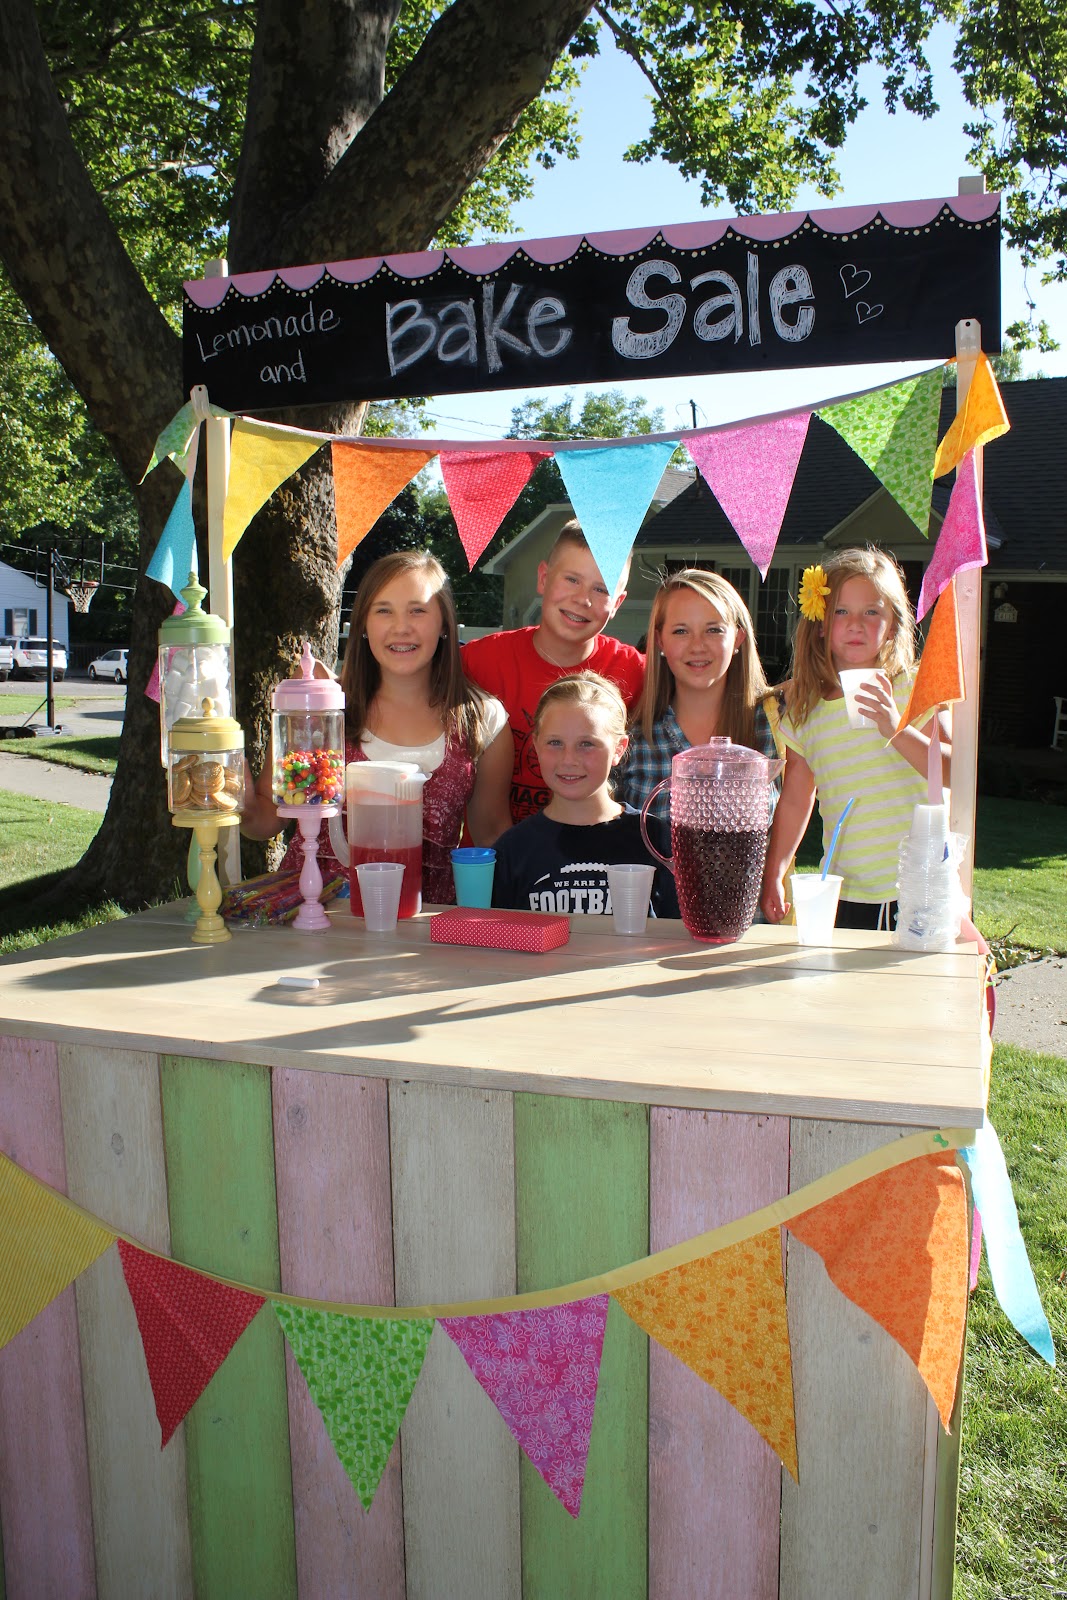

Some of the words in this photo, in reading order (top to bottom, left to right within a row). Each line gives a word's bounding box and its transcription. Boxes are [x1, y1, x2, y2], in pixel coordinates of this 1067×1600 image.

[196, 301, 341, 362] Lemonade
[611, 251, 817, 360] Sale
[259, 349, 308, 383] and
